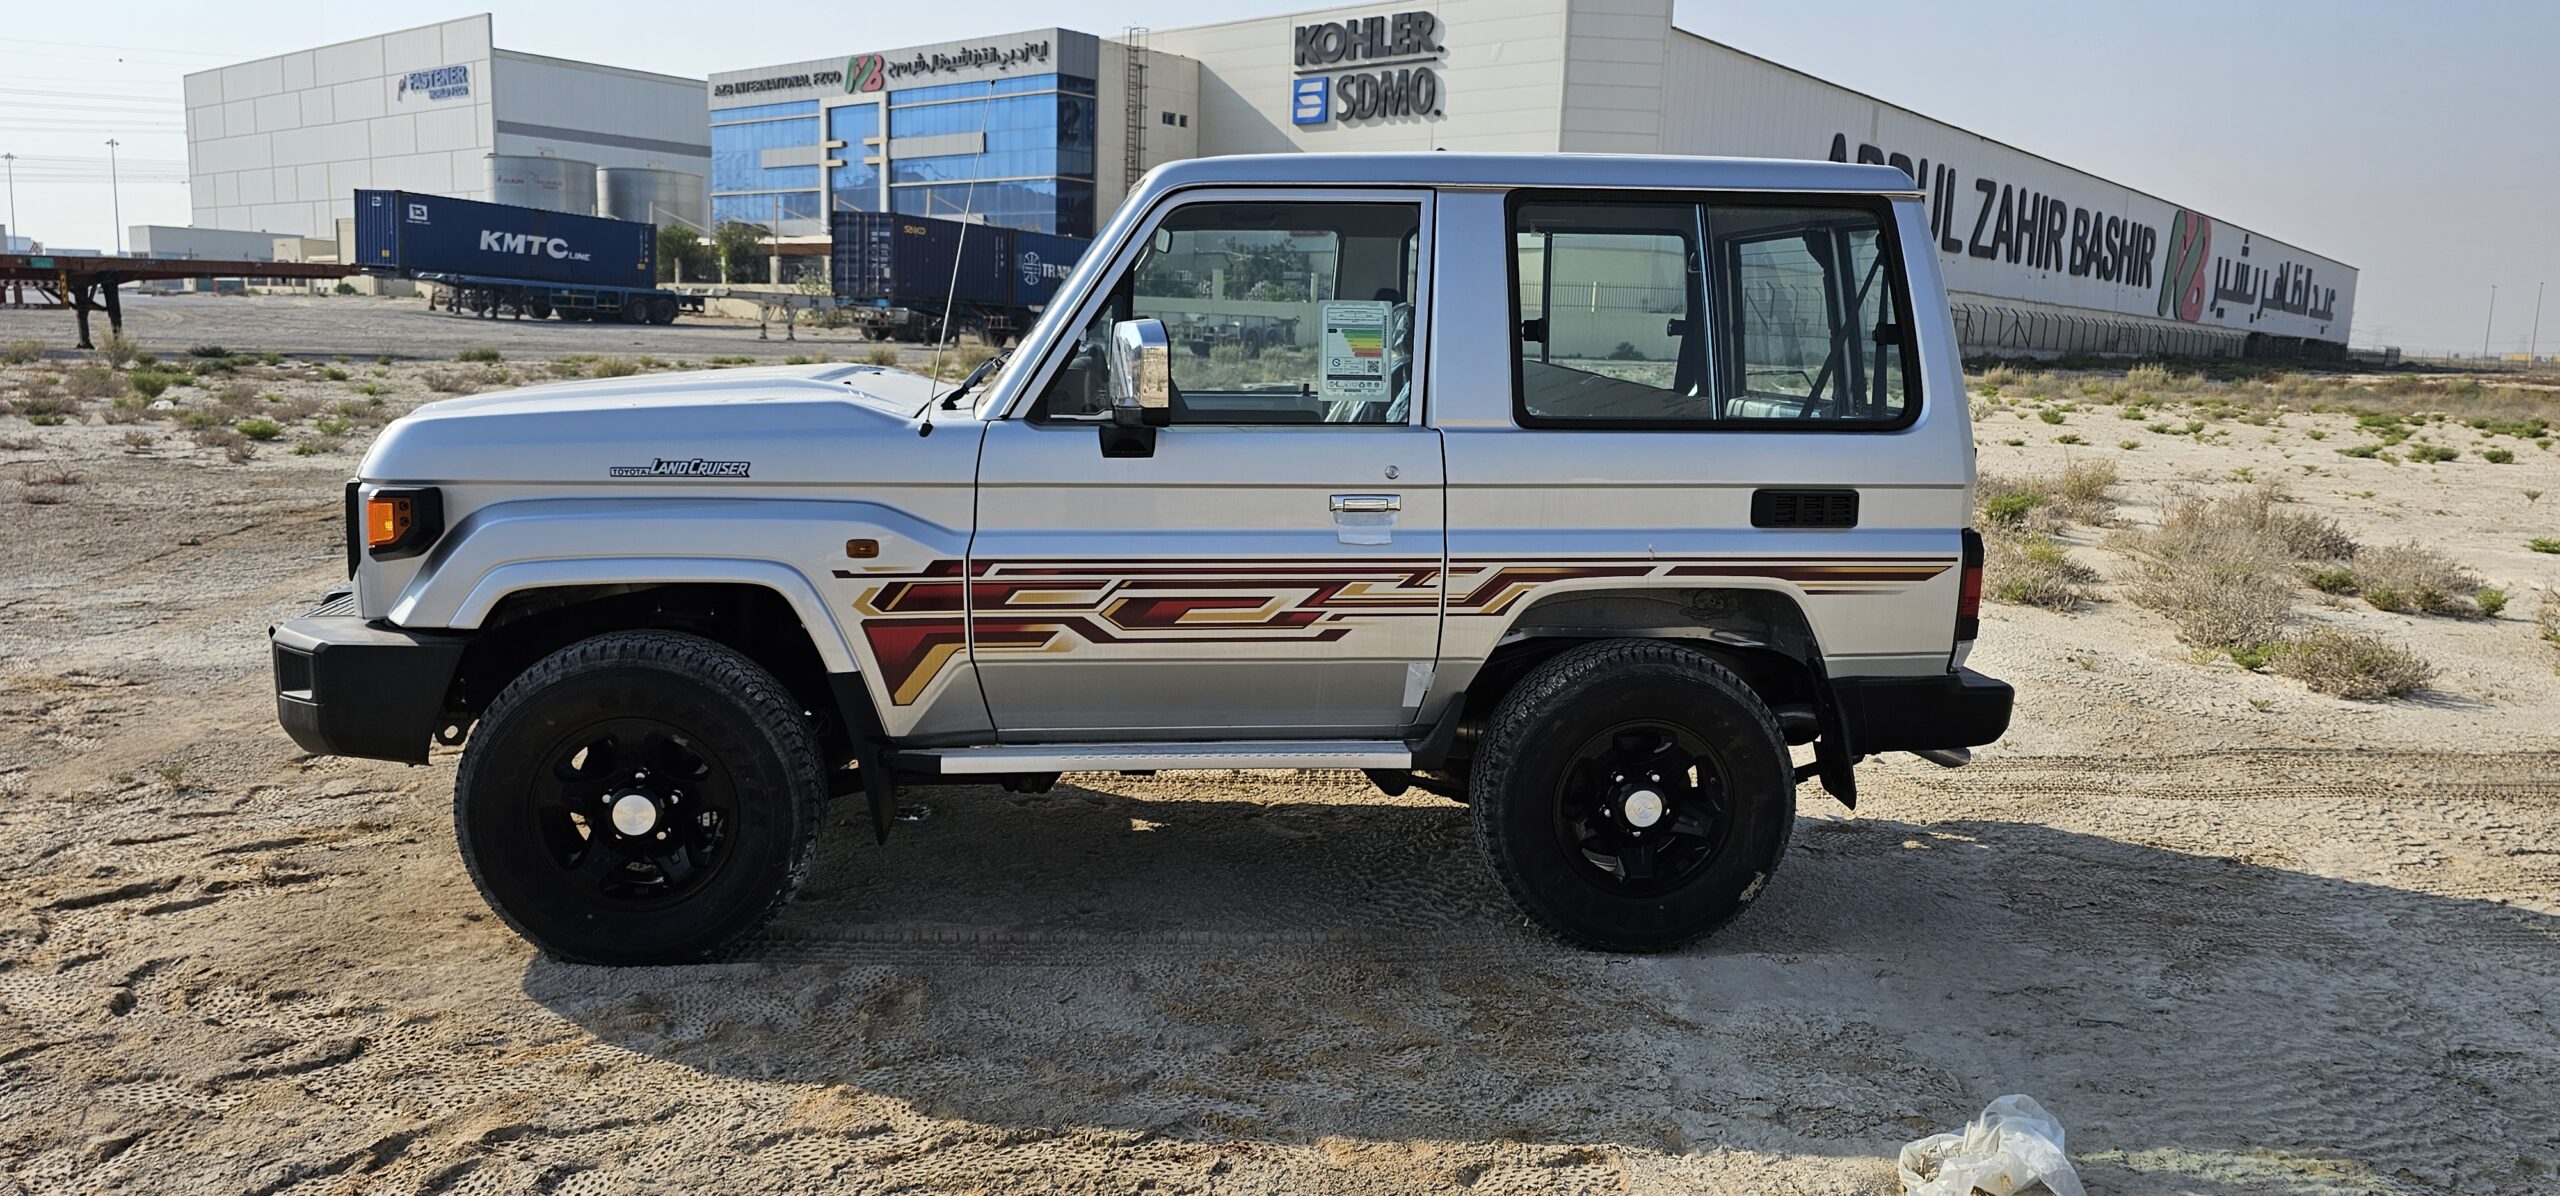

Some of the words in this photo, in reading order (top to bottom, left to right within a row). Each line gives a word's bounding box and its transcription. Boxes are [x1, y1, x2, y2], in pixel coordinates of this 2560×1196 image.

[409, 66, 468, 90] FASTENER
[735, 74, 812, 94] INTERNATIONAL
[813, 71, 842, 86] FZCO
[479, 230, 568, 260] KMTC
[568, 251, 592, 261] LINE
[1969, 178, 2067, 272] ZAHIR
[2069, 207, 2156, 289] BASHIR
[612, 467, 649, 477] TOYOTA
